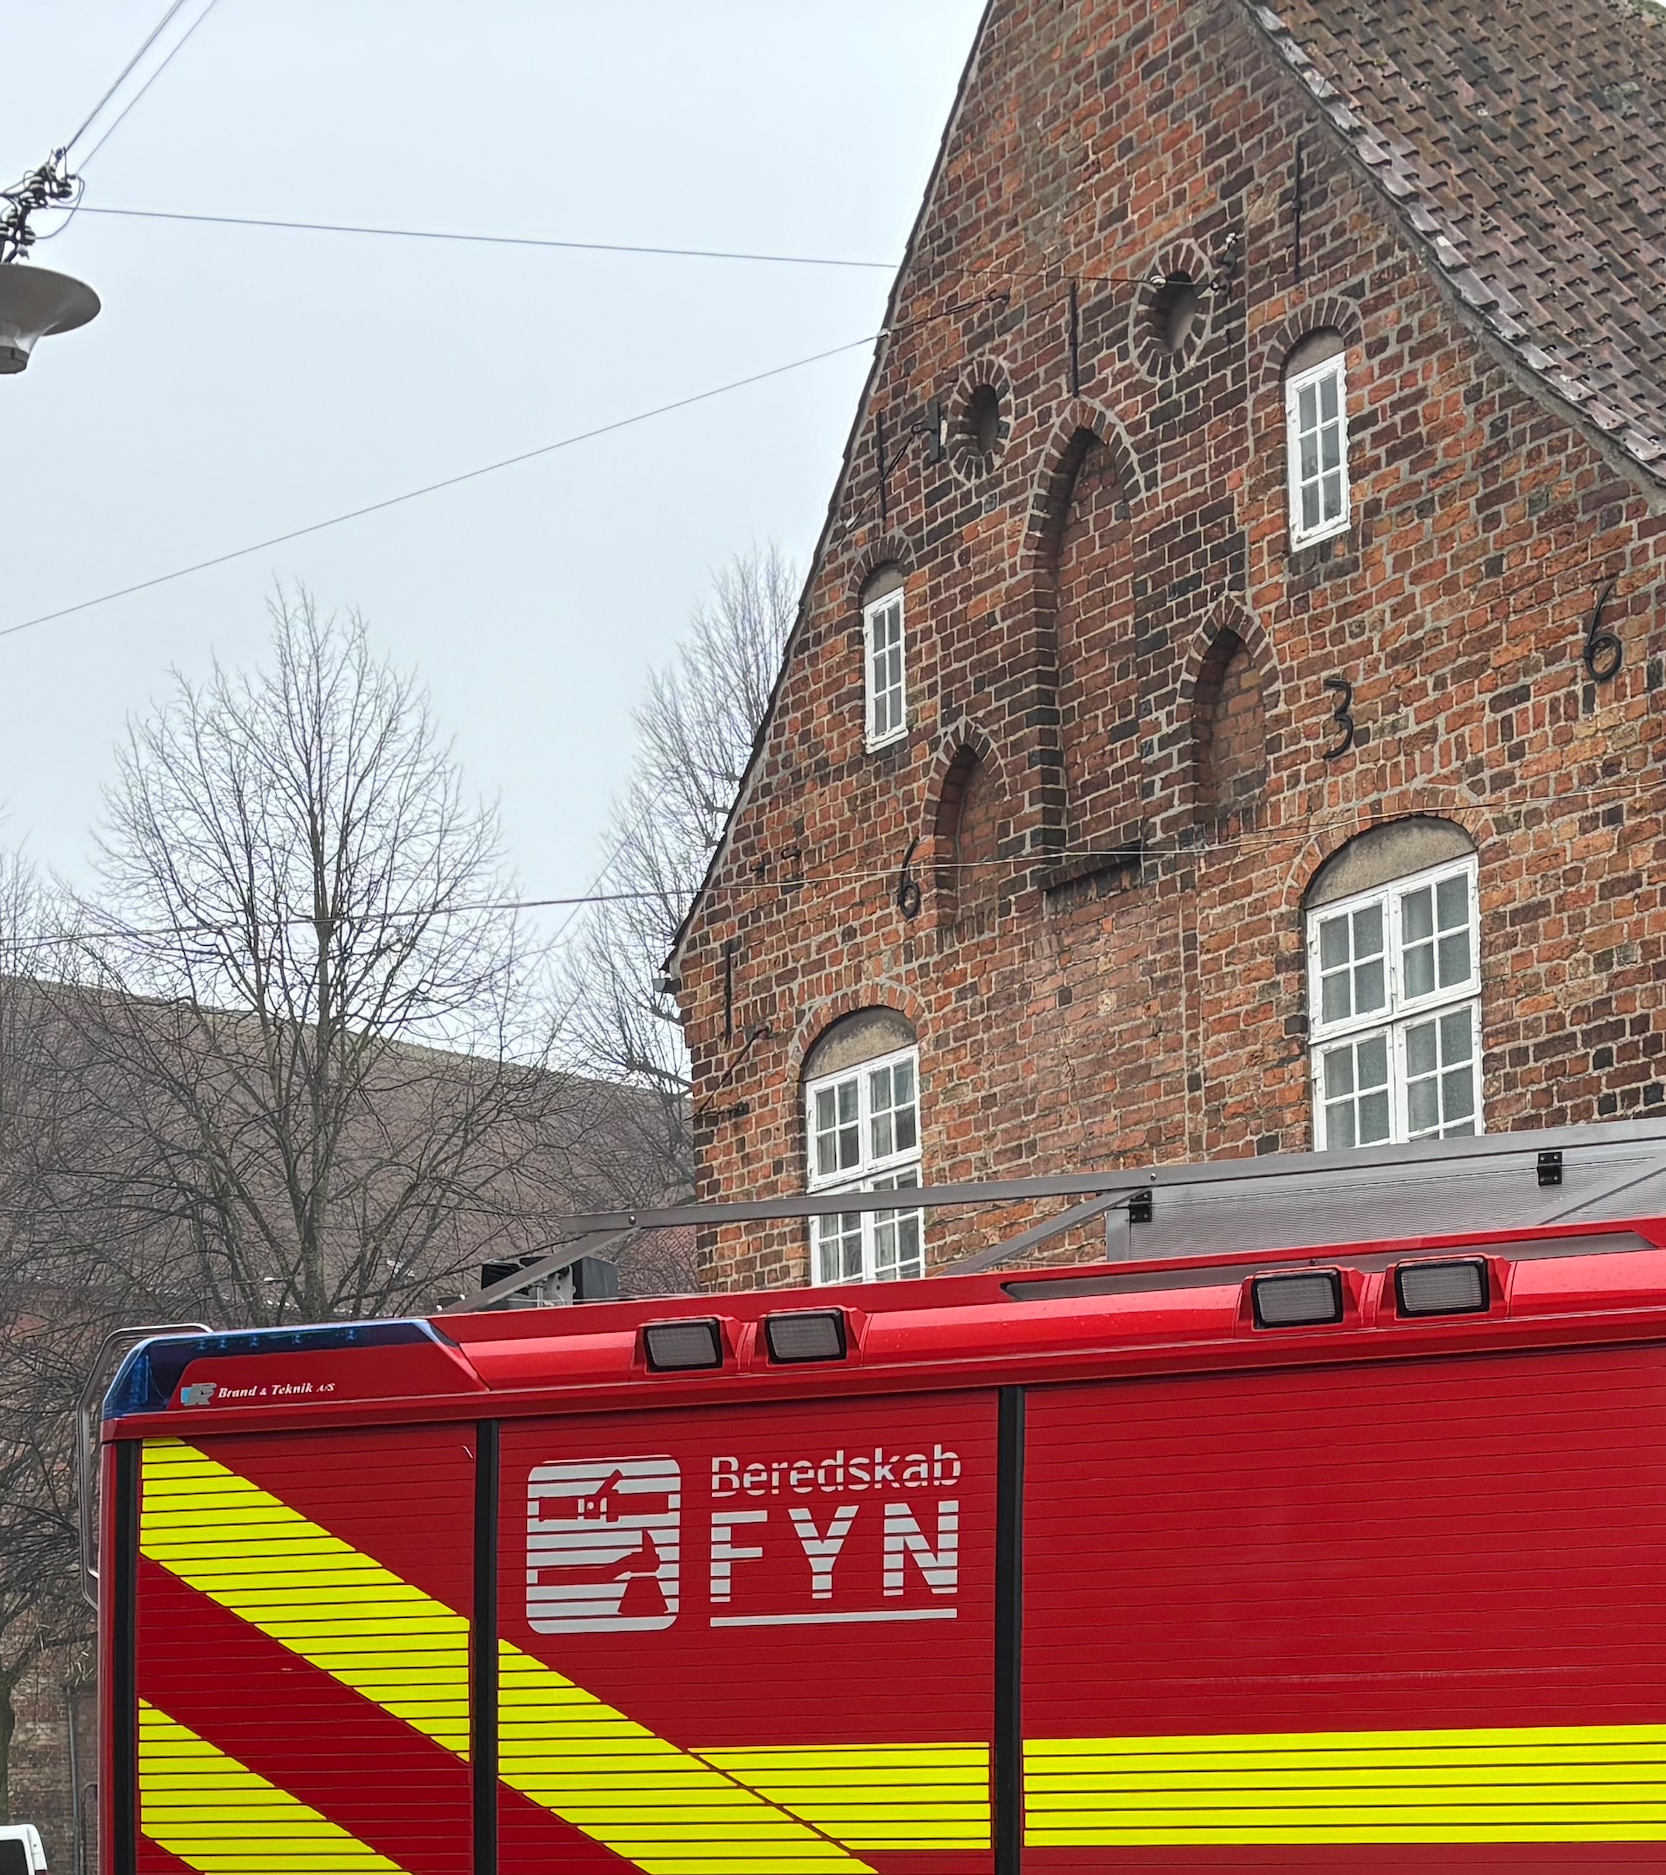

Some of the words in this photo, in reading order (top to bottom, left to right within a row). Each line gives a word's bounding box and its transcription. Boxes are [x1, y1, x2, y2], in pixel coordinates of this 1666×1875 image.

[218, 1386, 258, 1399] Brand
[259, 1387, 267, 1396] &
[271, 1383, 314, 1396] Teknik
[317, 1383, 336, 1393] A/S
[711, 1444, 961, 1498] Beredskab
[710, 1500, 960, 1603] FYN
